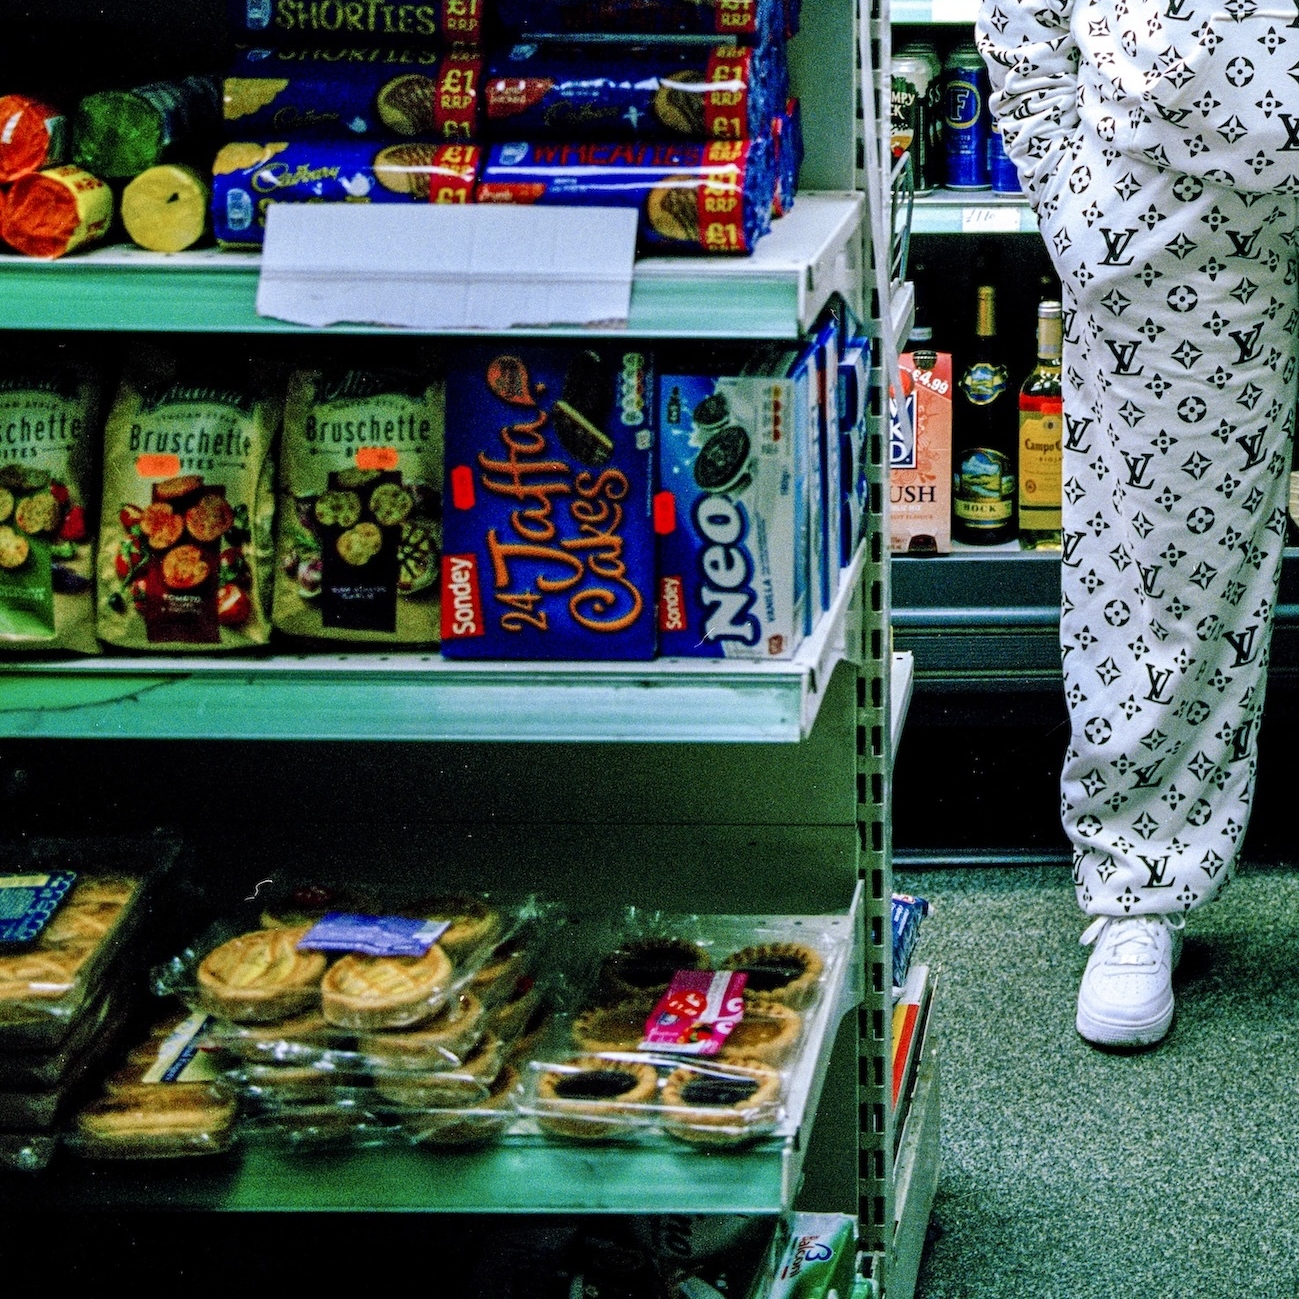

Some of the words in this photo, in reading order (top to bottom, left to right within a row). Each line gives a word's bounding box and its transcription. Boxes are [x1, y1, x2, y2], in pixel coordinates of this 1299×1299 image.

[441, 69, 474, 94] £1
[440, 95, 473, 109] RRP
[950, 89, 970, 121] F
[705, 198, 737, 212] RRP
[705, 223, 737, 246] £1
[129, 423, 252, 456] Bruschette
[305, 414, 431, 444] Bruschette
[1024, 438, 1054, 458] Campo
[561, 467, 643, 632] Cakes
[692, 494, 760, 647] Neo
[451, 557, 476, 635] Sondey
[495, 591, 548, 631] 24
[665, 577, 679, 629] Sondey
